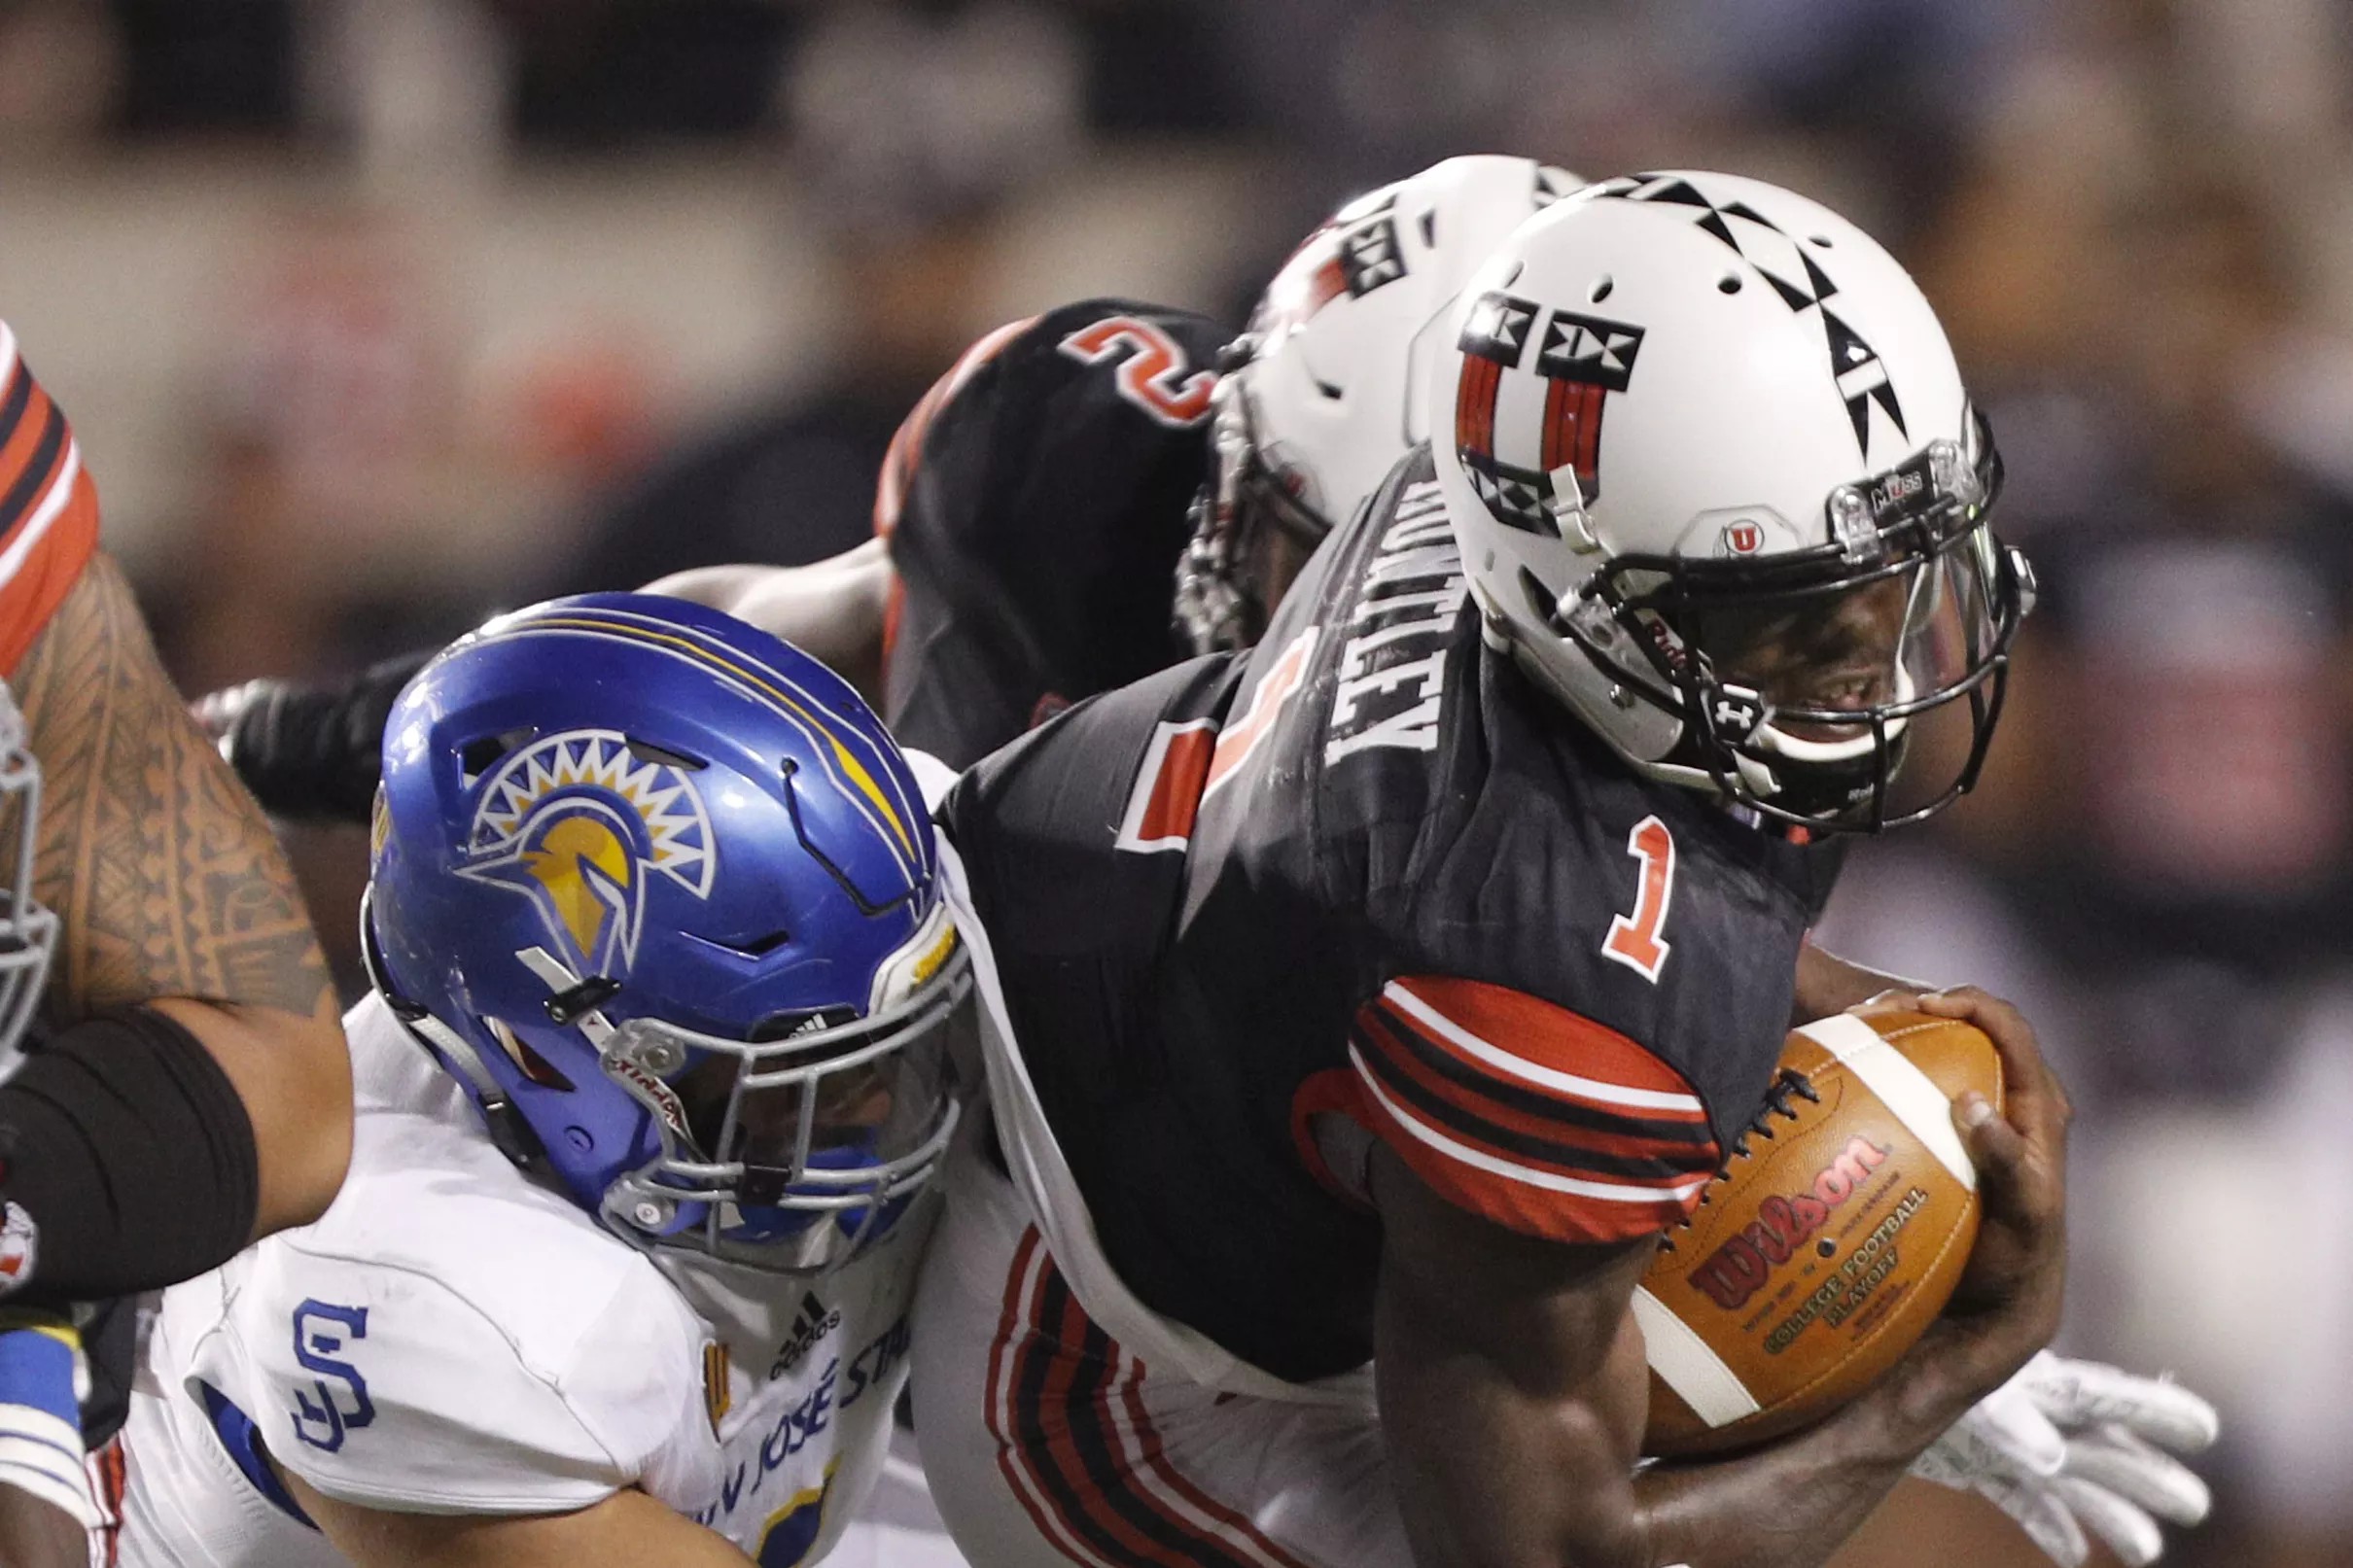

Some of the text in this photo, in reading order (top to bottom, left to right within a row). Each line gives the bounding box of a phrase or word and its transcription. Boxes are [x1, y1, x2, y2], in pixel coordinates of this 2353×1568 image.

[1057, 316, 1221, 430] 2
[1730, 526, 1757, 552] U
[1601, 814, 1676, 985] 1
[1688, 1137, 1887, 1309] Wilson
[1763, 1274, 1845, 1355] COLLEGE
[1842, 1185, 1929, 1280] FOOTBALL
[1822, 1245, 1899, 1329] PLAYOFF
